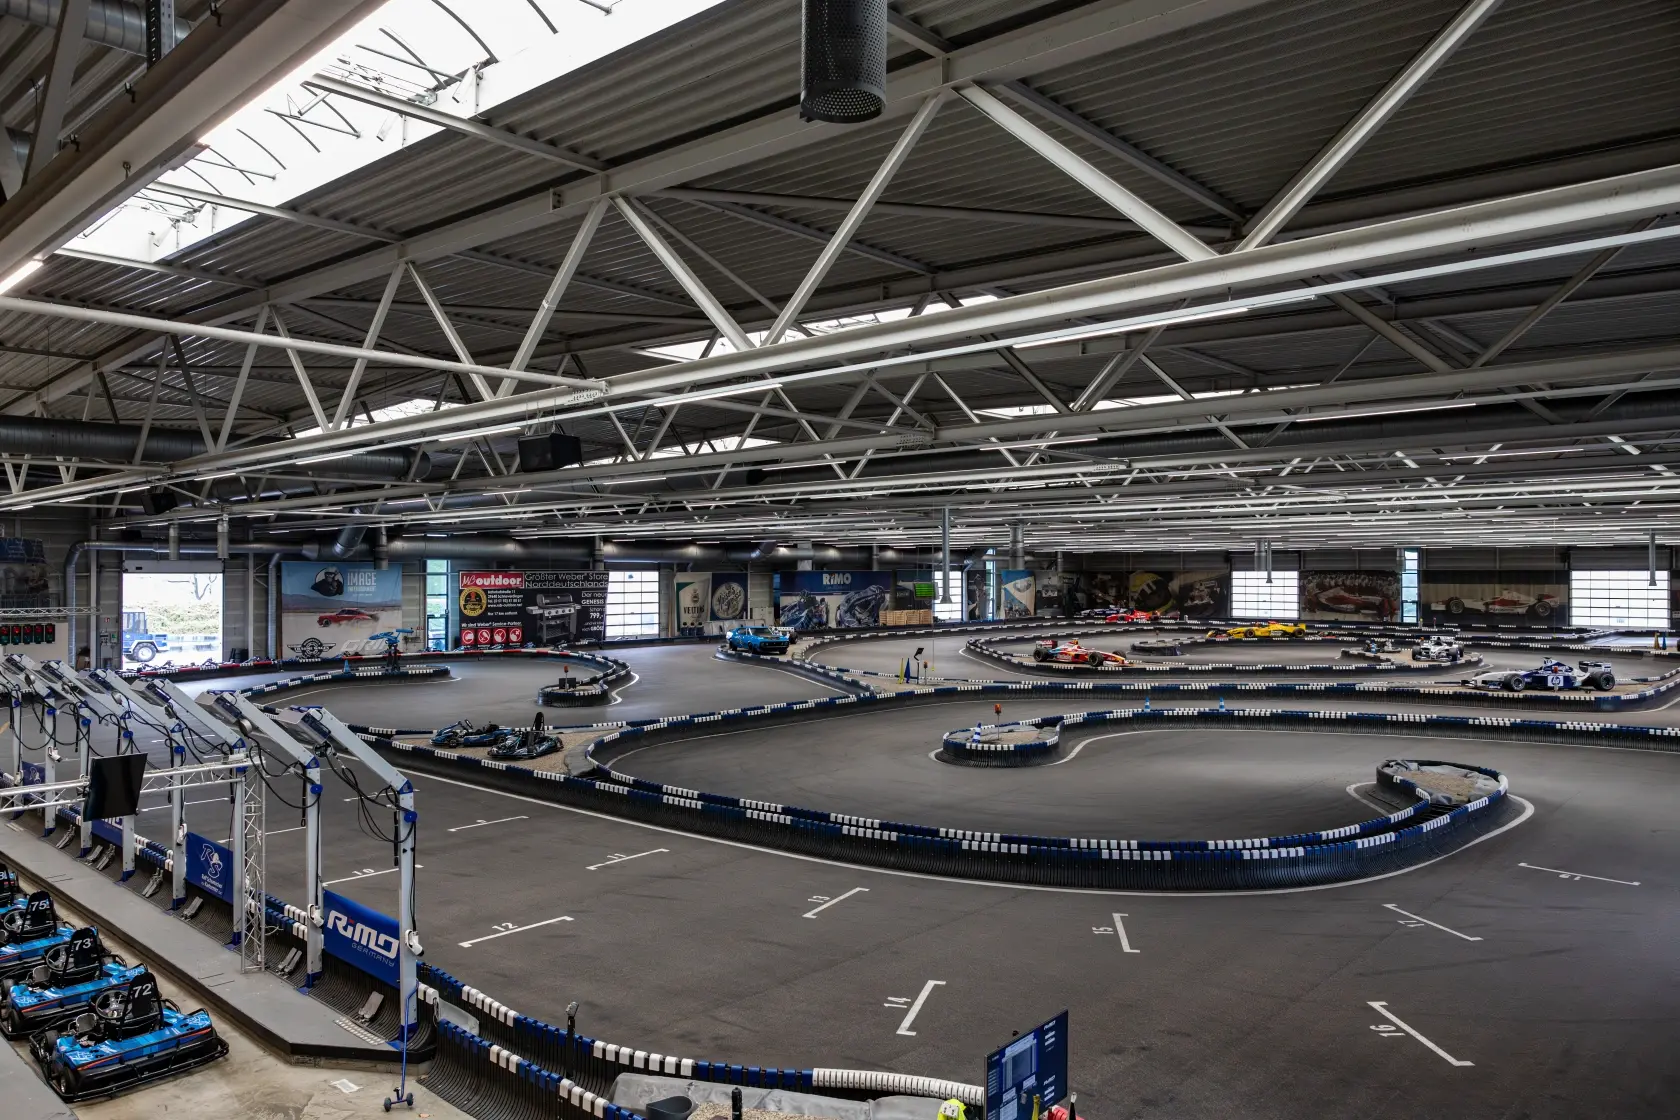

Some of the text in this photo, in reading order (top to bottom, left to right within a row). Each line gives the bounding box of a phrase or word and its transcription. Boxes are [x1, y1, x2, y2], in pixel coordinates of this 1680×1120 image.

[347, 572, 377, 586] IMAGE
[475, 574, 521, 586] outdoor
[525, 572, 557, 580] Größter
[588, 572, 608, 580] Store
[31, 900, 47, 912] 75
[491, 922, 518, 931] 12
[1091, 926, 1114, 934] 15
[73, 937, 92, 951] 73
[351, 942, 396, 968] GERMANY
[132, 983, 152, 999] 72
[883, 996, 911, 1008] 14
[1368, 1024, 1406, 1038] 16
